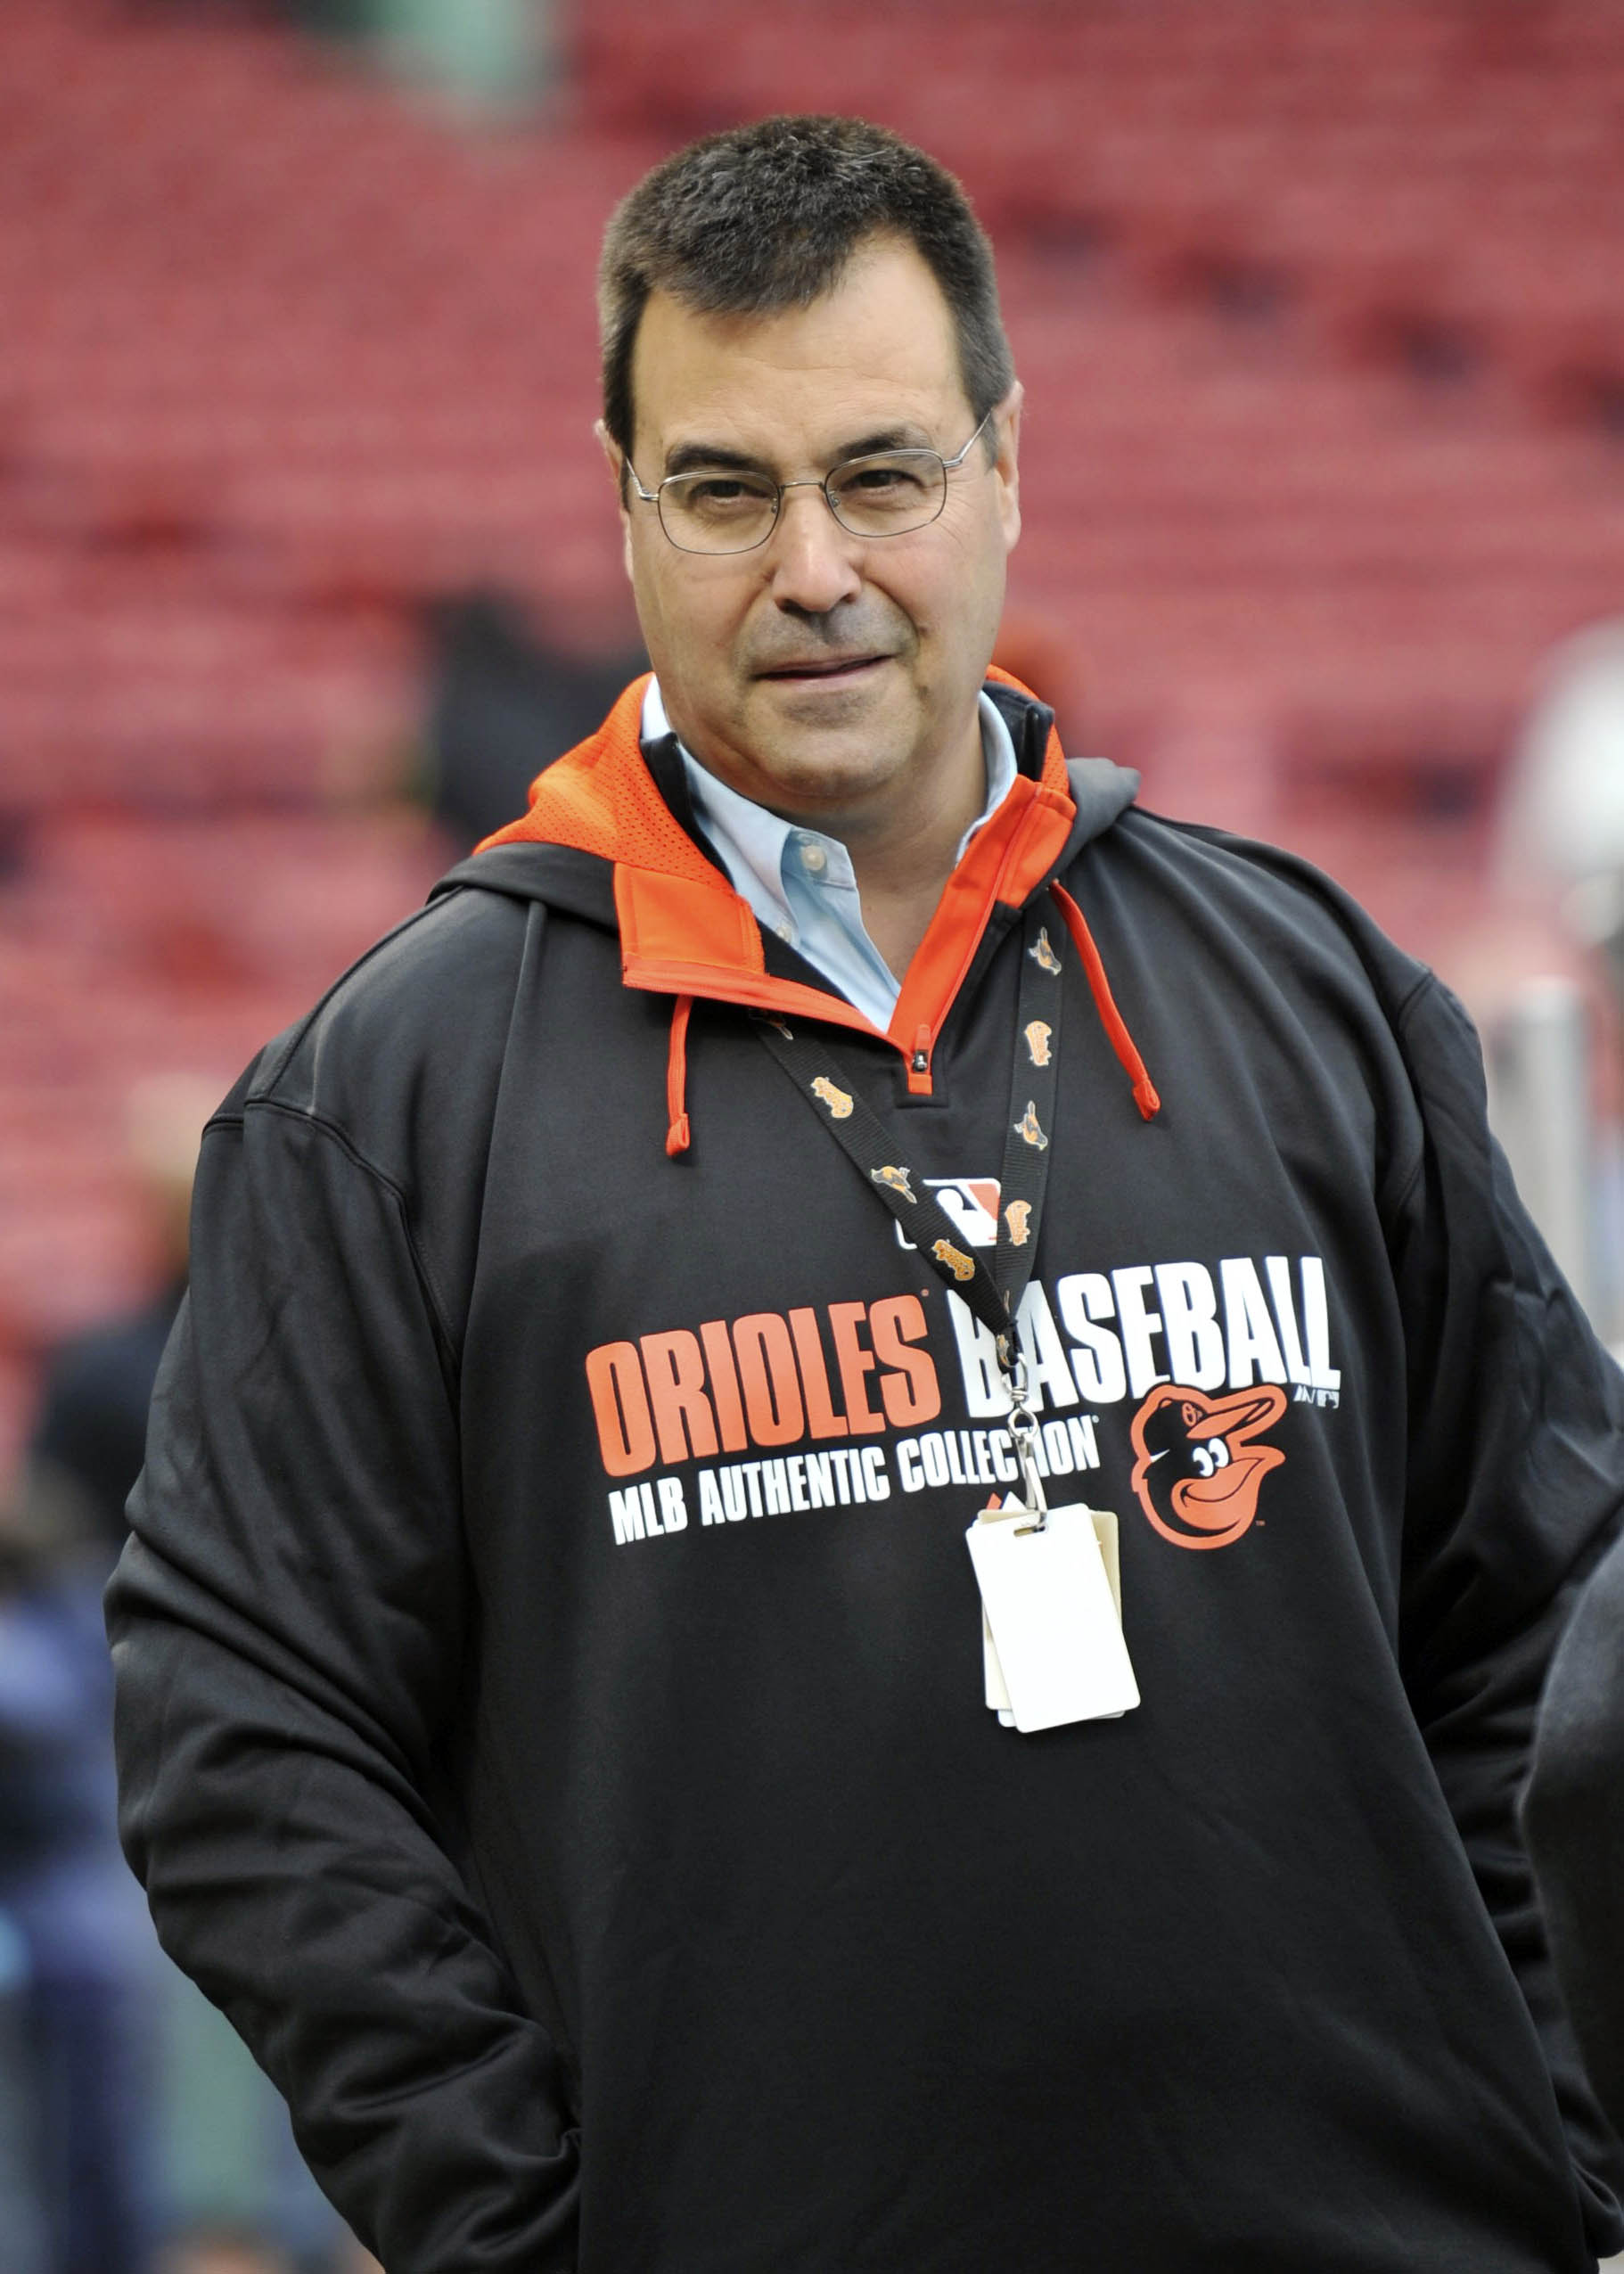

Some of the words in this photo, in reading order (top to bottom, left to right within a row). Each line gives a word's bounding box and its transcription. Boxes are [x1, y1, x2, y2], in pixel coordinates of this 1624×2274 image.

[585, 1294, 941, 1477] ORIOLES
[946, 1255, 1341, 1418] BASEBALL
[608, 1476, 688, 1546] MLB
[699, 1446, 891, 1526] AUTHENTIC
[896, 1415, 1101, 1493] COLLECION
